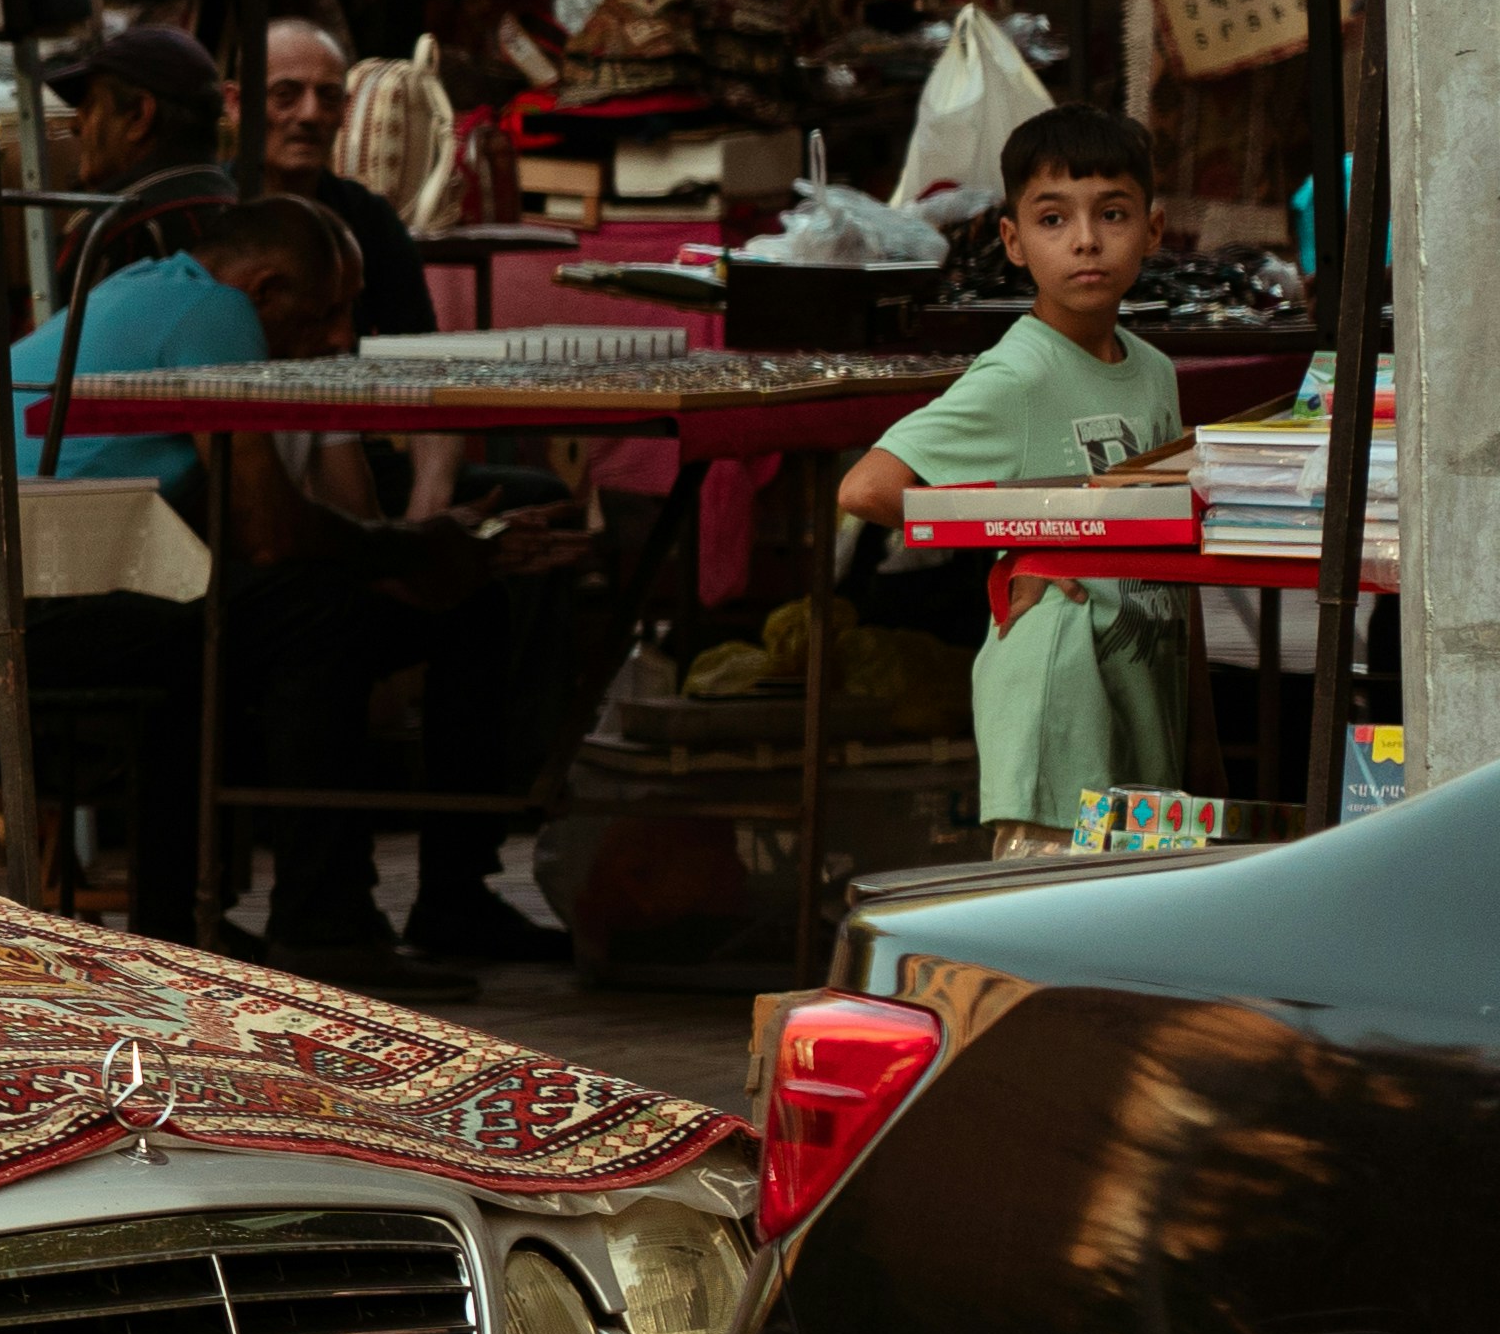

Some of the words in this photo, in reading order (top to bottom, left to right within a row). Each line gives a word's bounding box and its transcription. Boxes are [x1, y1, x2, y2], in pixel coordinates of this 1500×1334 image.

[984, 521, 1037, 536] DIE-CAST
[1039, 521, 1079, 536] METAL
[1080, 521, 1106, 536] CAR
